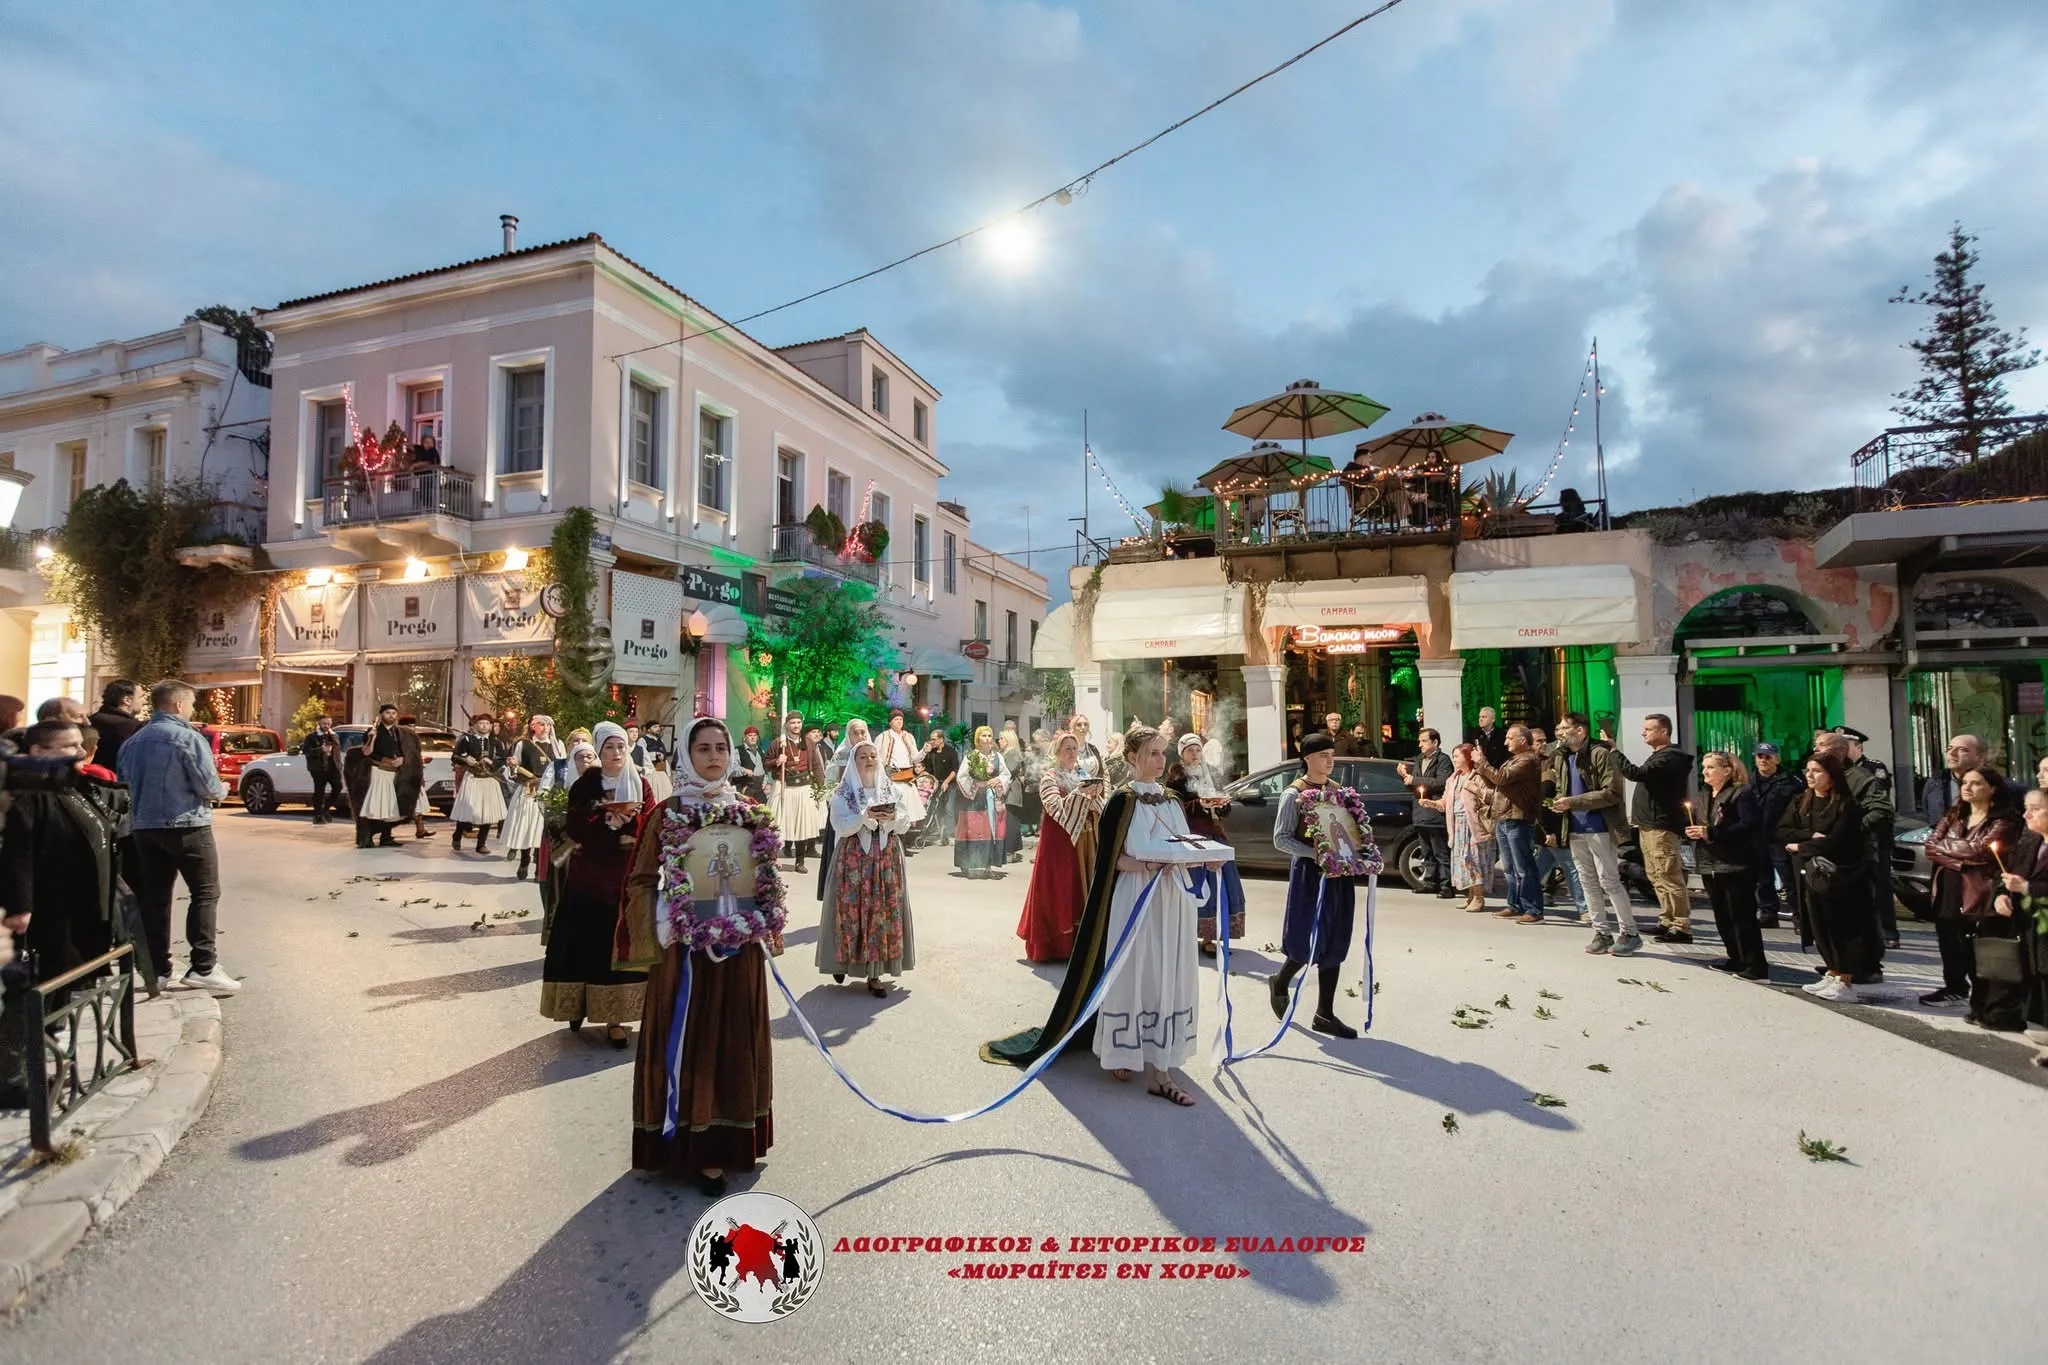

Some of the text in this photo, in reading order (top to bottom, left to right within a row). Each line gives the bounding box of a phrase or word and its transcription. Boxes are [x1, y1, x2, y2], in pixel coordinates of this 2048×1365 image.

[1321, 607, 1357, 616] CAMPARI
[387, 619, 437, 637] Prego
[483, 612, 537, 629] Prego
[196, 632, 238, 648] Prego
[295, 625, 339, 642] Prego
[1295, 624, 1361, 644] Banana
[1518, 628, 1559, 637] CAMPARI
[623, 639, 668, 661] Prego
[1144, 640, 1177, 648] CAMPARI
[1327, 643, 1366, 653] GARDEN
